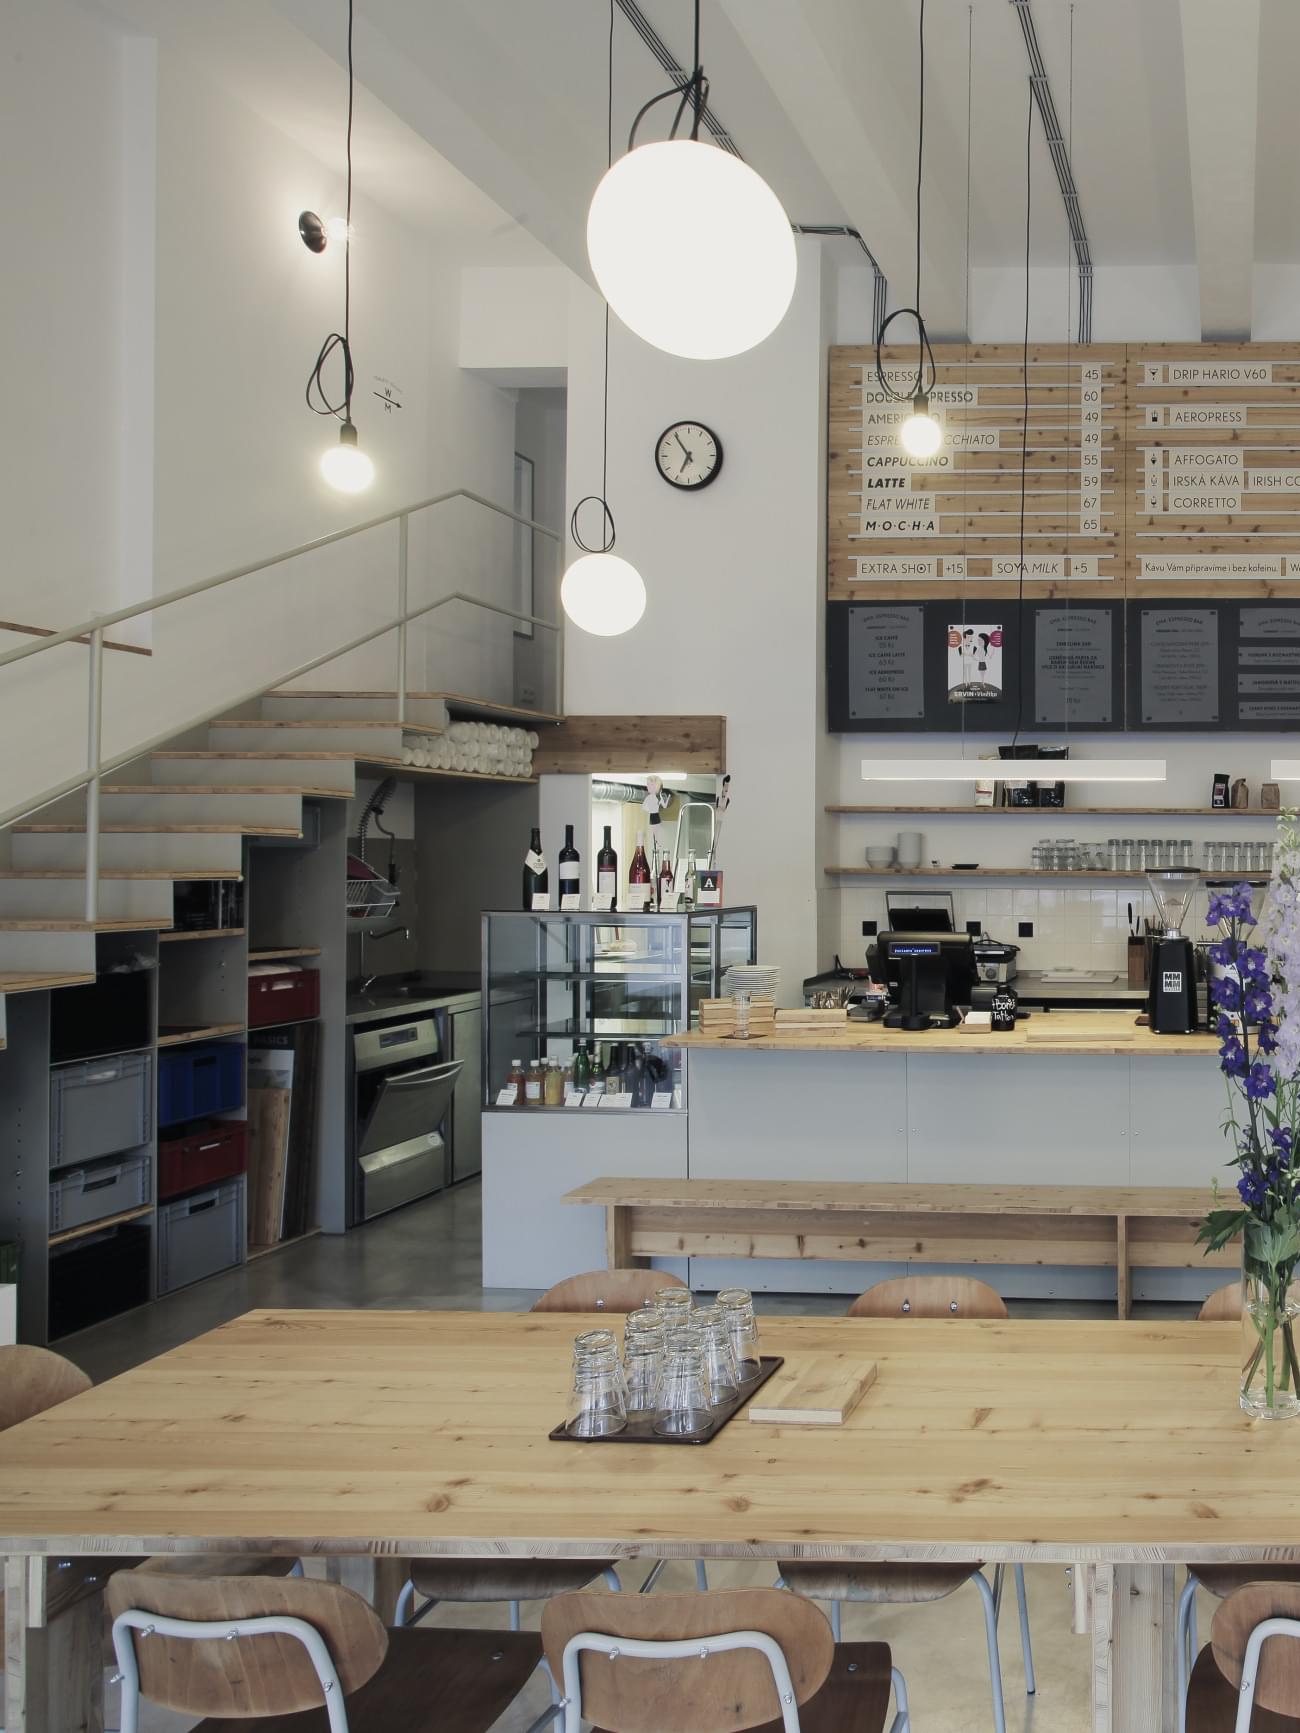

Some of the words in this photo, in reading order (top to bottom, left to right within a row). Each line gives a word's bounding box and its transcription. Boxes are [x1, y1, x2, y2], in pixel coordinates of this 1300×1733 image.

[1084, 370, 1098, 380] 45
[1173, 369, 1199, 380] DRIP
[1203, 369, 1241, 380] HARIO
[1244, 369, 1267, 380] V60
[923, 391, 974, 403] PRESSO
[1084, 391, 1098, 401] 60
[1084, 412, 1098, 422] 49
[1175, 411, 1242, 423] AEROPRESS
[1084, 433, 1098, 443] 49
[867, 456, 948, 467] CAPPUCCINO
[1084, 455, 1098, 465] 55
[1174, 454, 1239, 465] AFFOGATO
[867, 478, 906, 489] LATTE
[1084, 476, 1098, 487] 59
[1173, 474, 1207, 487] IRSKÁ
[1210, 474, 1240, 487] KÁVA
[1253, 475, 1282, 487] IRISH
[866, 499, 891, 510] FLAT
[895, 499, 930, 510] WHITE
[1083, 498, 1097, 508] 67
[1173, 497, 1237, 508] CORRETTO
[1083, 519, 1098, 530] 65
[861, 563, 897, 574] EXTRA
[945, 563, 964, 574] +15
[997, 563, 1029, 574] SOYA
[1032, 562, 1059, 574] MILK
[1073, 562, 1088, 574] +5
[1232, 563, 1247, 572] bez
